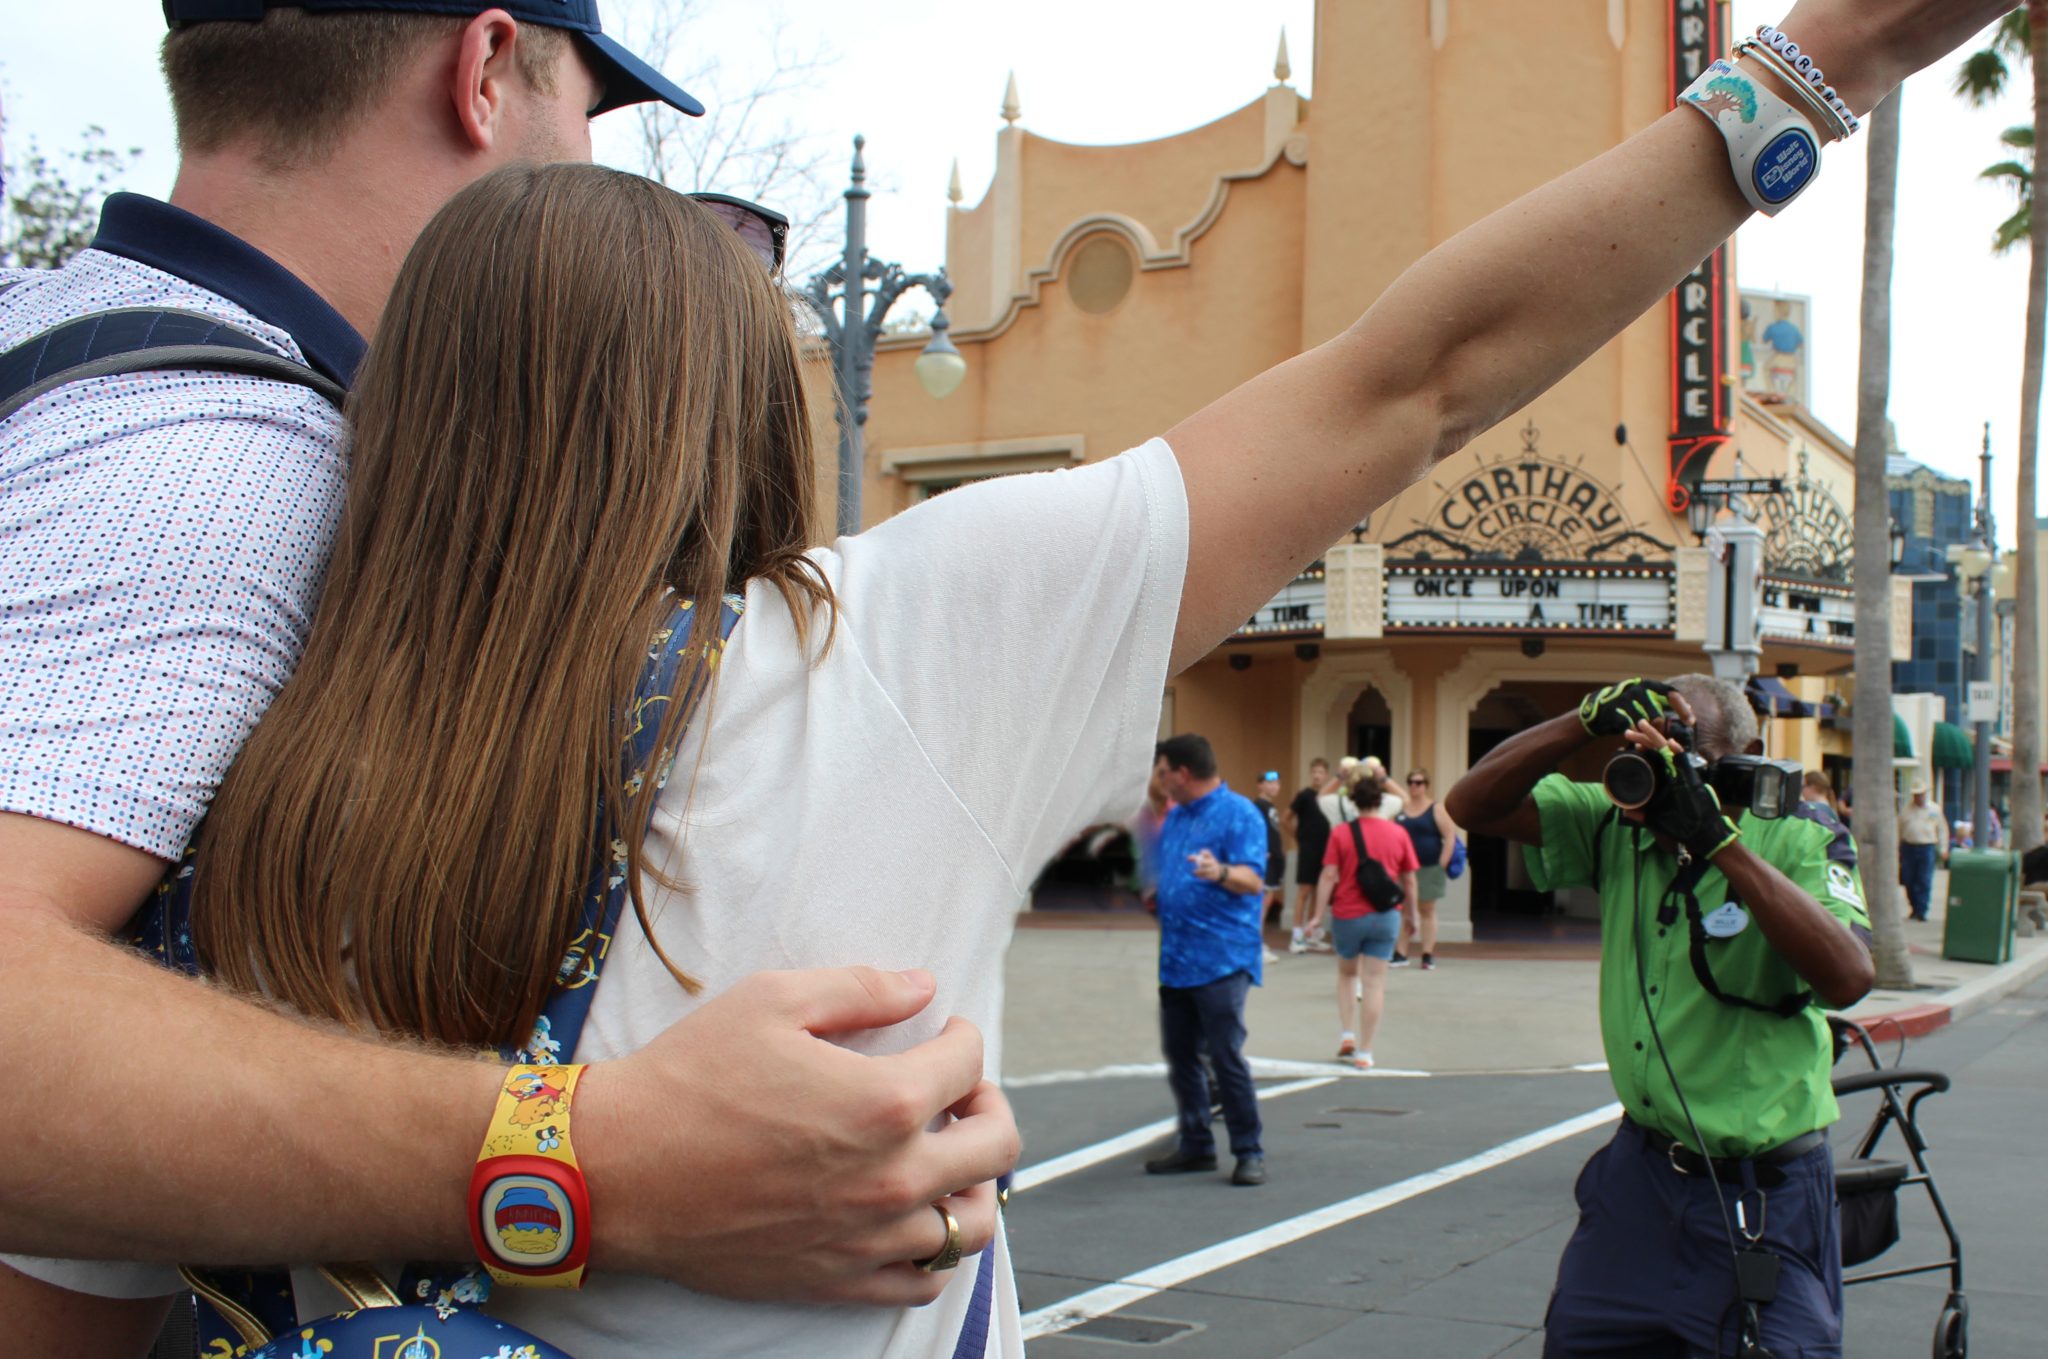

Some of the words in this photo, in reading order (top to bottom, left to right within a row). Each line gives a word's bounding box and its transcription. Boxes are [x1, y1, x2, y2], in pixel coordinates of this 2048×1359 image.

[1760, 26, 1822, 84] EVERY
[1776, 140, 1800, 164] Walt
[1781, 158, 1809, 184] World
[1441, 463, 1622, 532] CARTHAY
[1700, 482, 1750, 493] HIGHLAND
[1478, 501, 1582, 540] CIRCLE
[1414, 578, 1474, 597] ONCE
[1500, 579, 1560, 598] UPON
[1529, 602, 1544, 620] A
[1577, 603, 1629, 621] TIME
